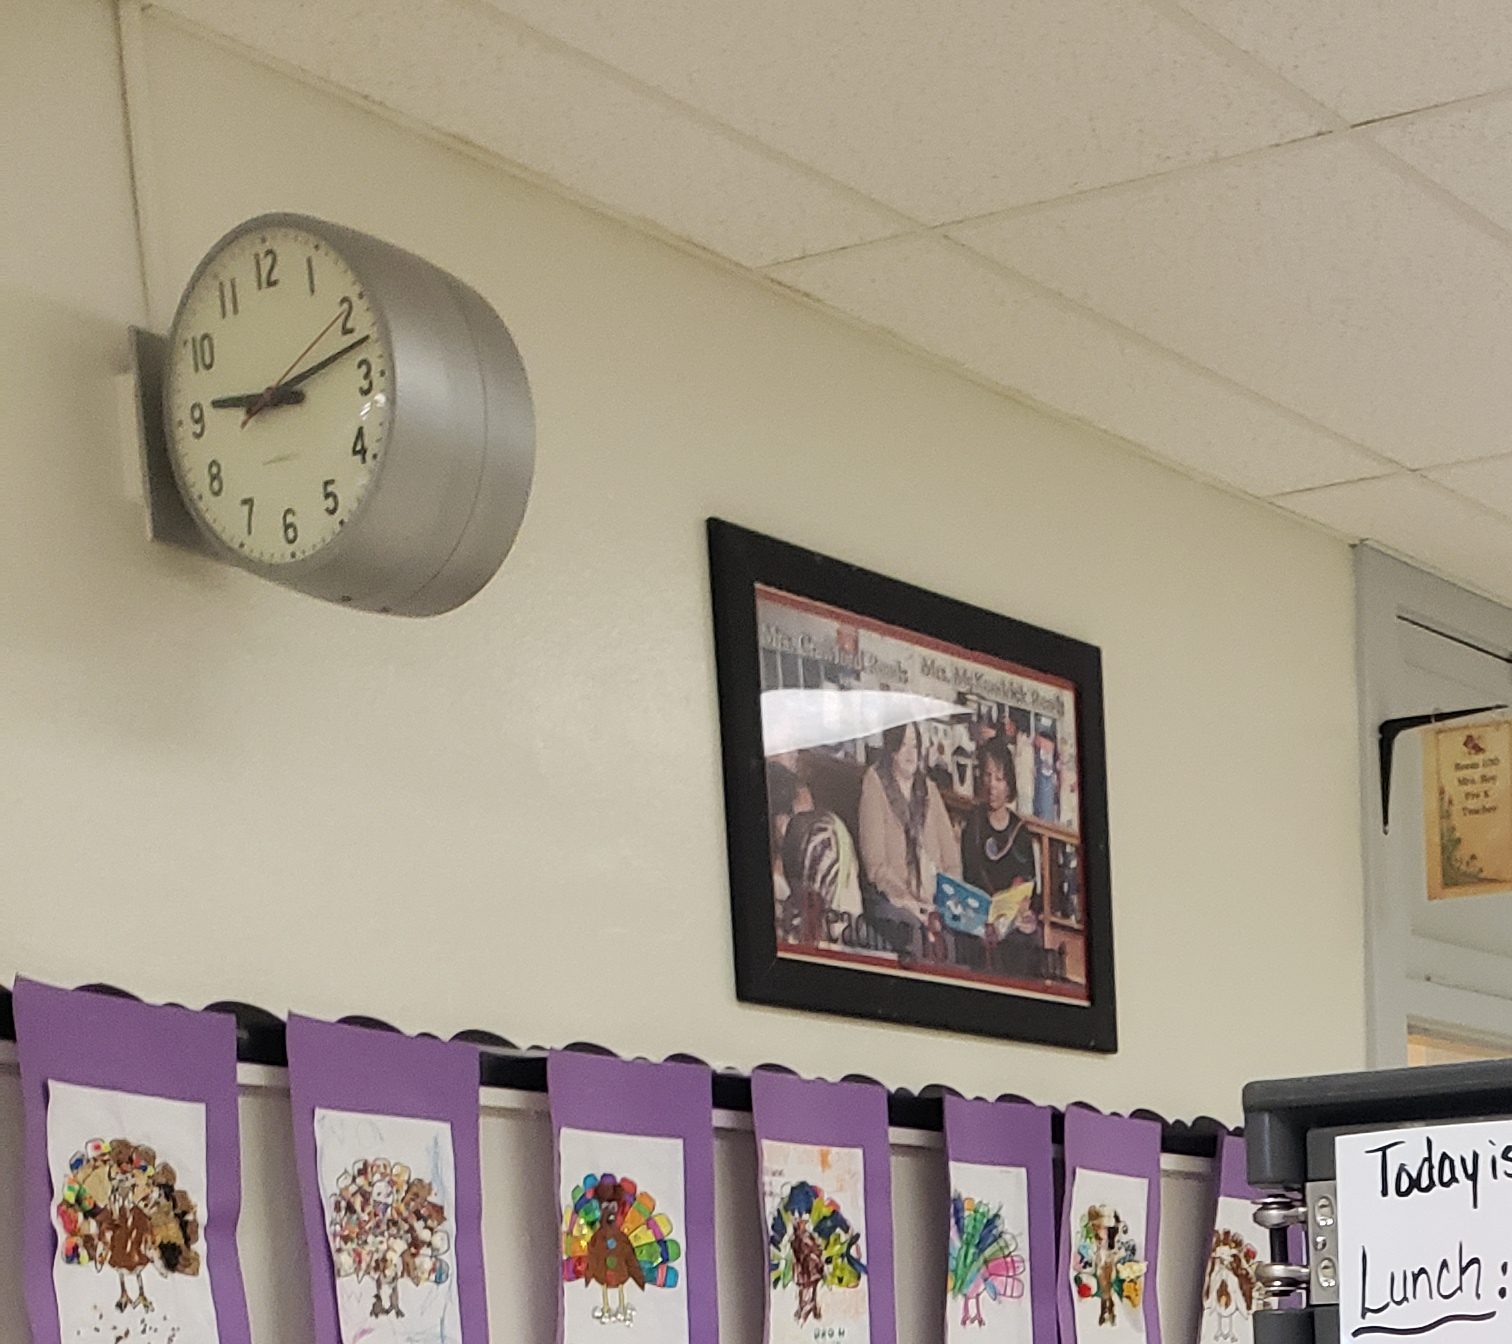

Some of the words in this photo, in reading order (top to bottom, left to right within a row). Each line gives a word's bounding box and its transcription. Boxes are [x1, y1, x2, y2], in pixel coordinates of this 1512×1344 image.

[254, 248, 279, 291] 12
[306, 256, 315, 296] 1
[218, 277, 239, 320] 11
[340, 296, 354, 336] 2
[191, 332, 215, 373] 10
[357, 358, 374, 396] 3
[190, 402, 206, 439] 9
[352, 426, 368, 465] 4
[208, 459, 223, 497] 8
[323, 478, 339, 515] 5
[240, 497, 254, 536] 7
[282, 507, 298, 544] 6
[1365, 1137, 1479, 1209] Today
